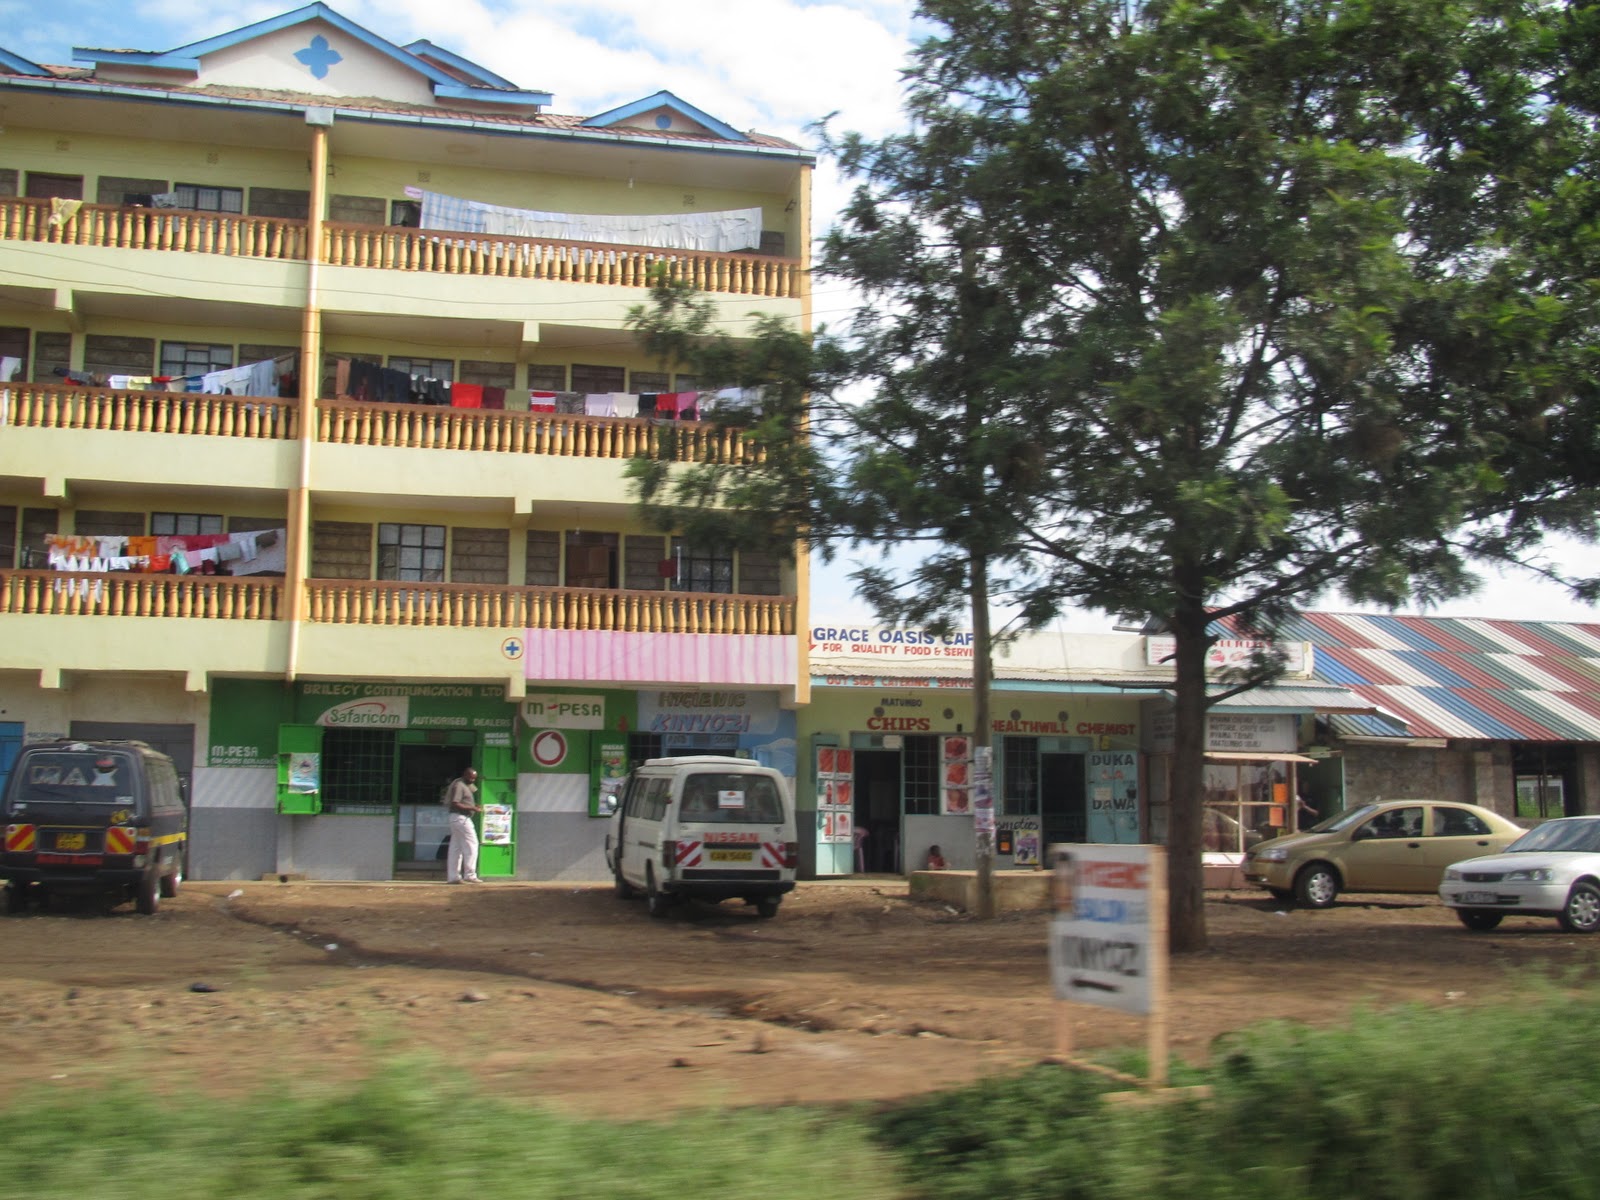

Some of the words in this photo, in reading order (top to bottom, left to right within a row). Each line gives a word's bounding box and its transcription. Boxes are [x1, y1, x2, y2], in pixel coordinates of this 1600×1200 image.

[813, 627, 869, 642] GRACE
[879, 629, 935, 645] OASIS
[942, 632, 975, 646] CAF
[822, 643, 843, 653] FOR
[851, 644, 897, 655] QUALITY
[904, 646, 931, 656] FOOD
[934, 647, 941, 656] &
[943, 647, 975, 657] SERVI
[826, 676, 848, 686] OUT
[853, 677, 875, 687] SIDE
[881, 677, 930, 688] CATERING
[938, 678, 976, 689] SERVIC
[364, 684, 474, 697] COMMUNICATION
[480, 687, 503, 697] LTD
[330, 708, 400, 725] Safaricom
[650, 713, 752, 733] KINYOZI
[866, 716, 931, 731] CHIPS
[991, 719, 1069, 734] HEALTHWILL
[1076, 721, 1137, 736] CHEMIST
[211, 745, 259, 758] M-PESA
[1091, 754, 1135, 767] DUKA
[1092, 798, 1136, 811] DAWA
[703, 831, 761, 843] NISSAN
